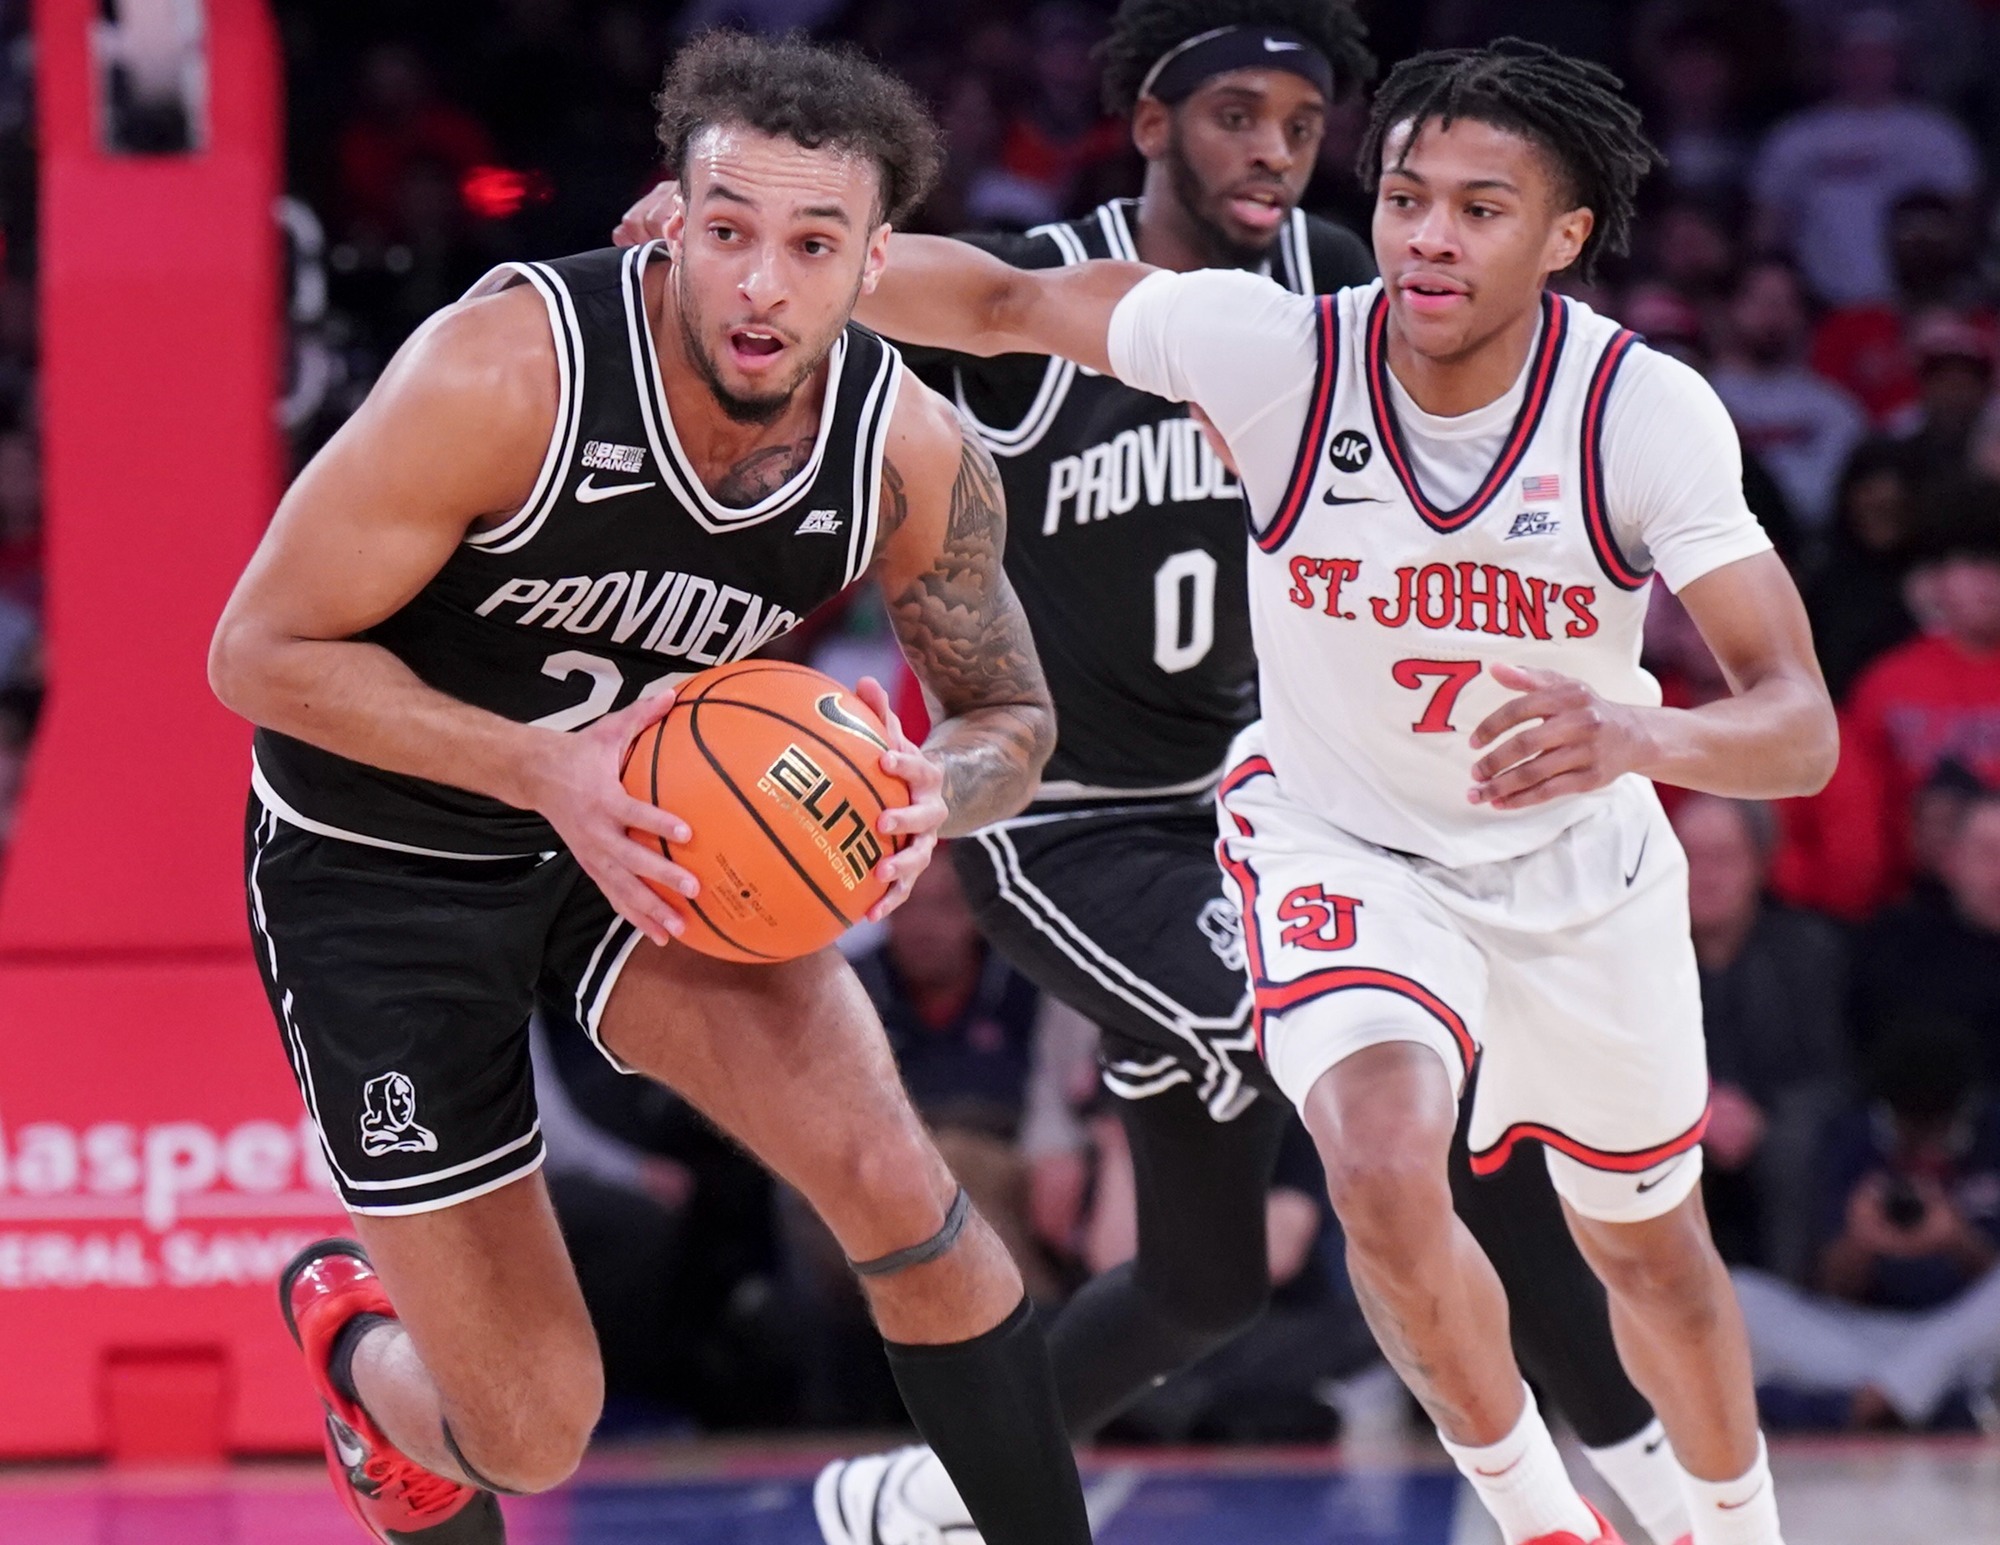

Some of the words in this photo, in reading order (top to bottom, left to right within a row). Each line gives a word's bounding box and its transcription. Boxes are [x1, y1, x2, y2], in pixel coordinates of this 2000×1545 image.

[580, 456, 643, 474] CHANGE
[1333, 438, 1368, 465] JK
[798, 520, 843, 531] EAST
[805, 510, 838, 521] BIG
[1508, 521, 1560, 536] EAST
[1514, 511, 1550, 523] BIG
[474, 570, 804, 667] PROVIDENC
[1153, 548, 1217, 674] 0
[1289, 555, 1362, 621] ST.
[1369, 562, 1600, 640] JOHN'S
[527, 650, 701, 734] 2
[1391, 658, 1482, 733] 7
[765, 743, 884, 883] ELITE
